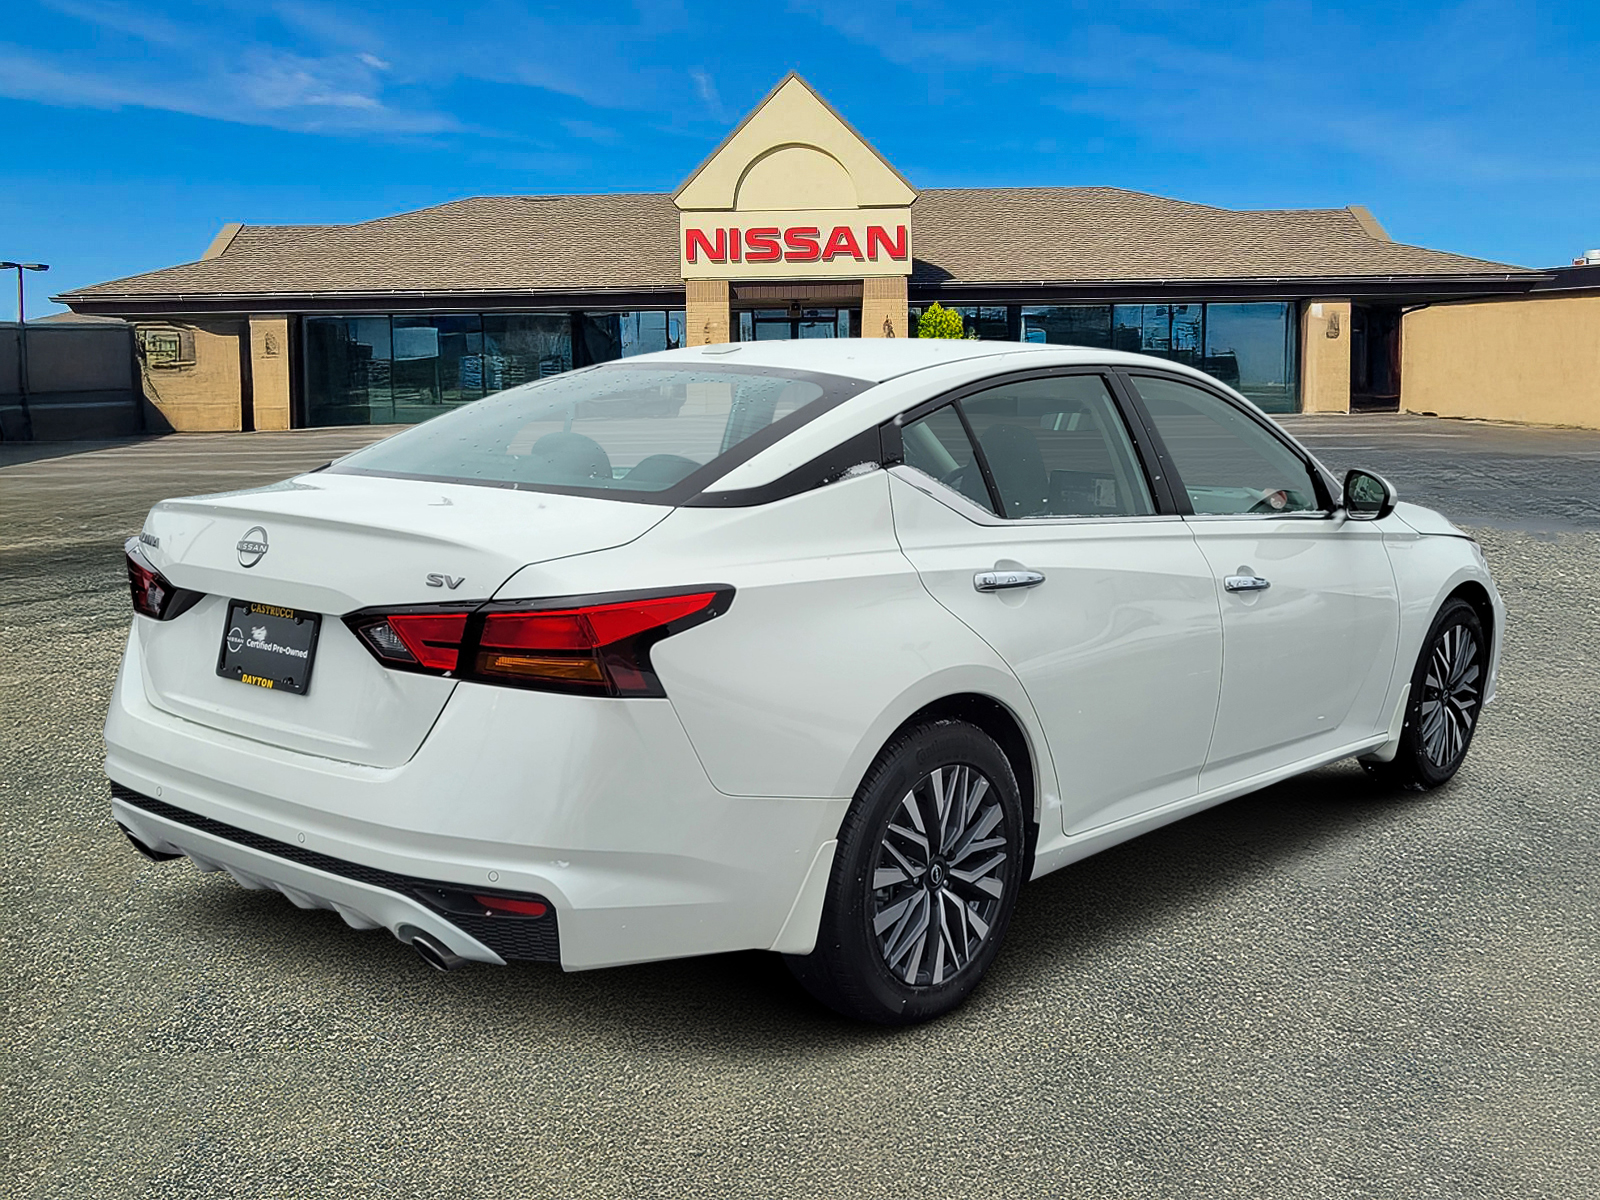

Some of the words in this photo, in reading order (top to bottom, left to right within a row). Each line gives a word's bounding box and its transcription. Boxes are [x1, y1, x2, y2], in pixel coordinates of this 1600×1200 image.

[685, 225, 908, 264] NISSAN
[425, 573, 466, 590] SV
[250, 603, 294, 619] CASTRUCCI
[246, 638, 273, 651] Certified
[272, 643, 308, 659] Pre-Owned
[241, 673, 274, 689] DAYTON
